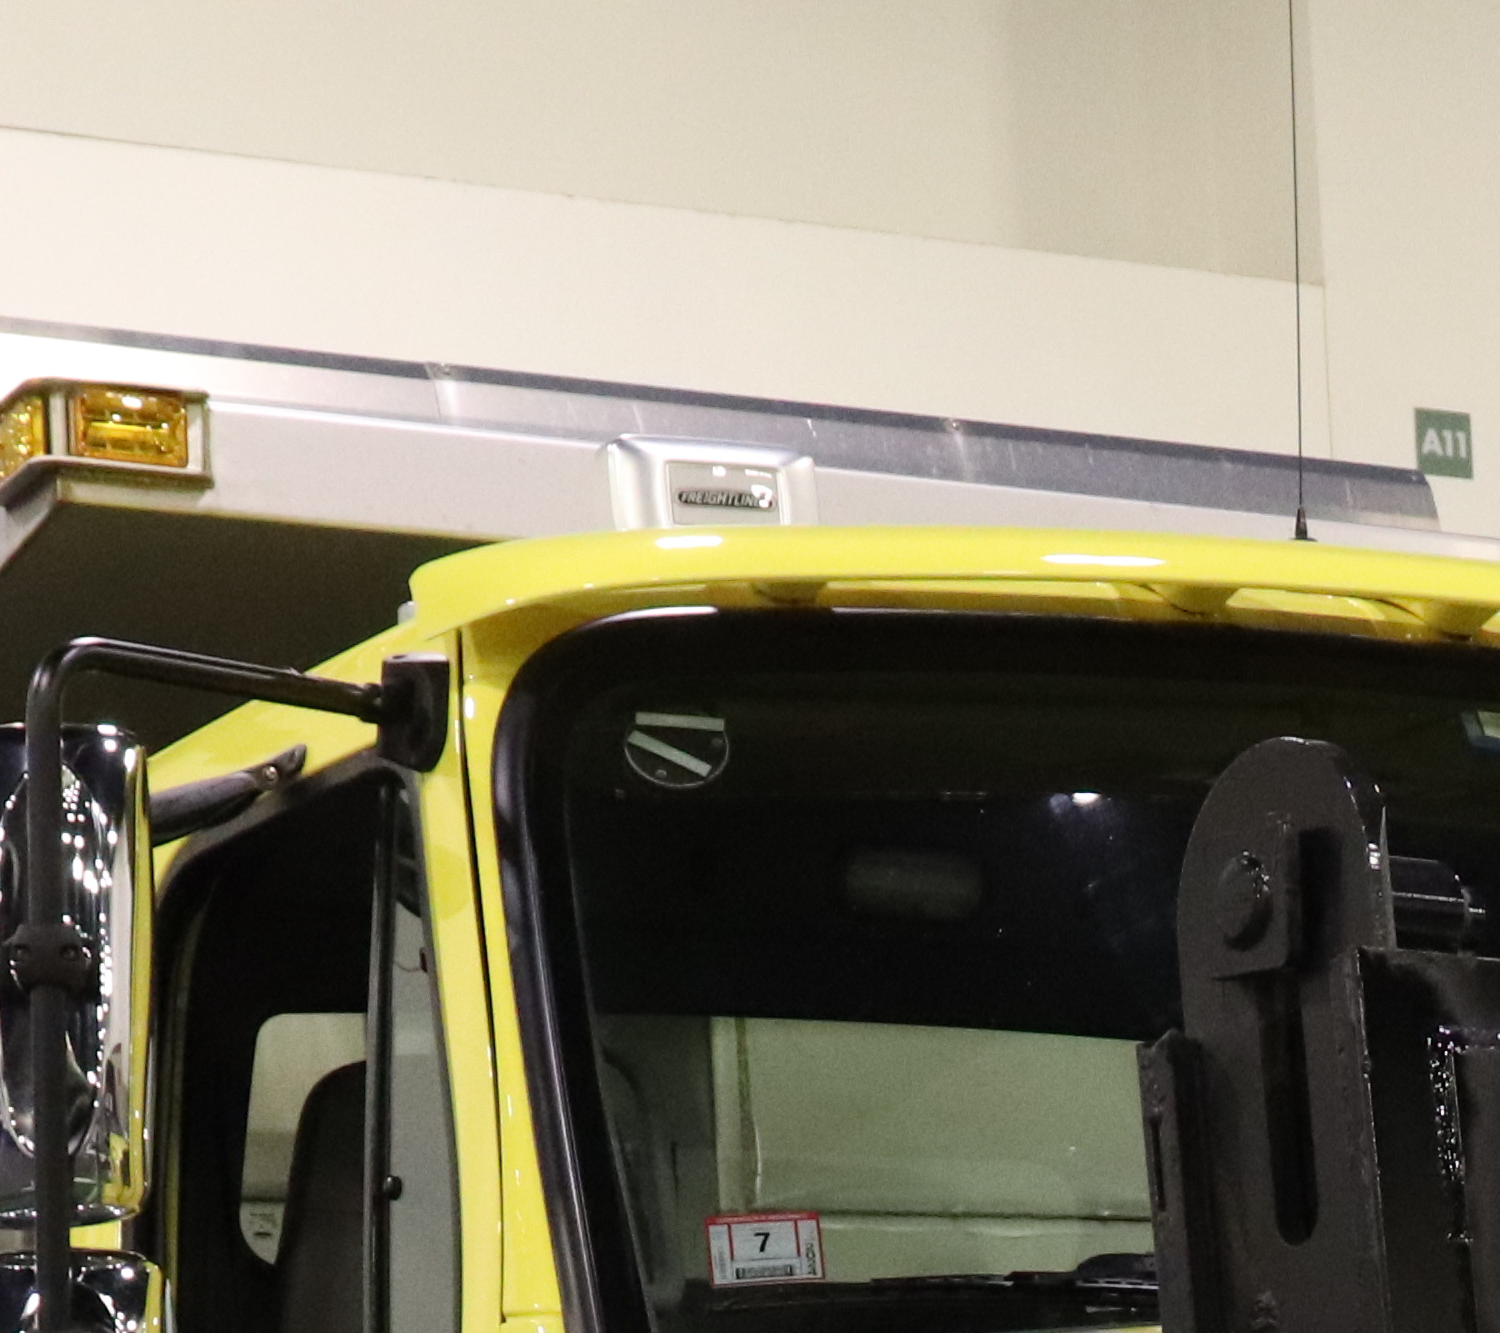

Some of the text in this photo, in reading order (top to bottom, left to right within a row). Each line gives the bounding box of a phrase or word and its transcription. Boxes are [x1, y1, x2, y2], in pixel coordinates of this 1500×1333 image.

[1421, 428, 1467, 458] A11
[680, 491, 771, 508] FREIGHTLIN
[754, 1232, 770, 1252] 7
